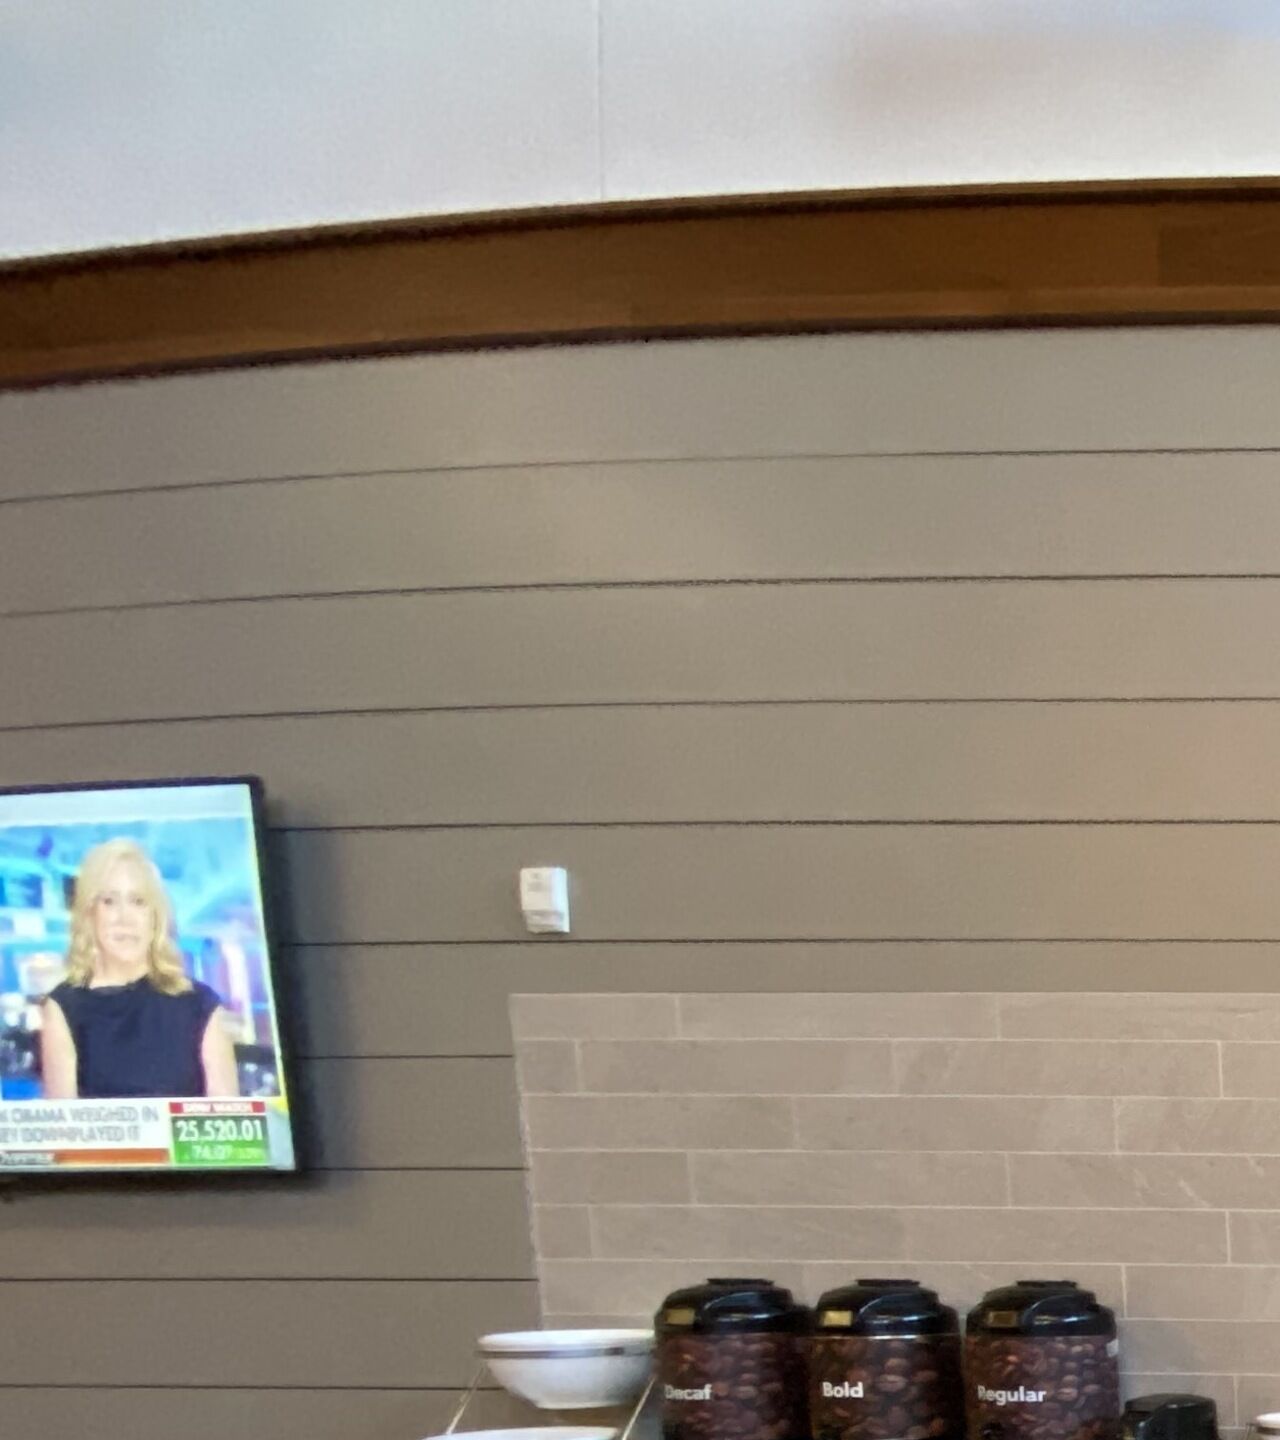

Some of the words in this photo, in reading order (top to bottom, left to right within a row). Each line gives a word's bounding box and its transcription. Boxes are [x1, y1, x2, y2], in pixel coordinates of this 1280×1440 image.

[664, 1383, 712, 1400] Decaf
[822, 1382, 864, 1398] Bold
[977, 1384, 1047, 1406] Regular
